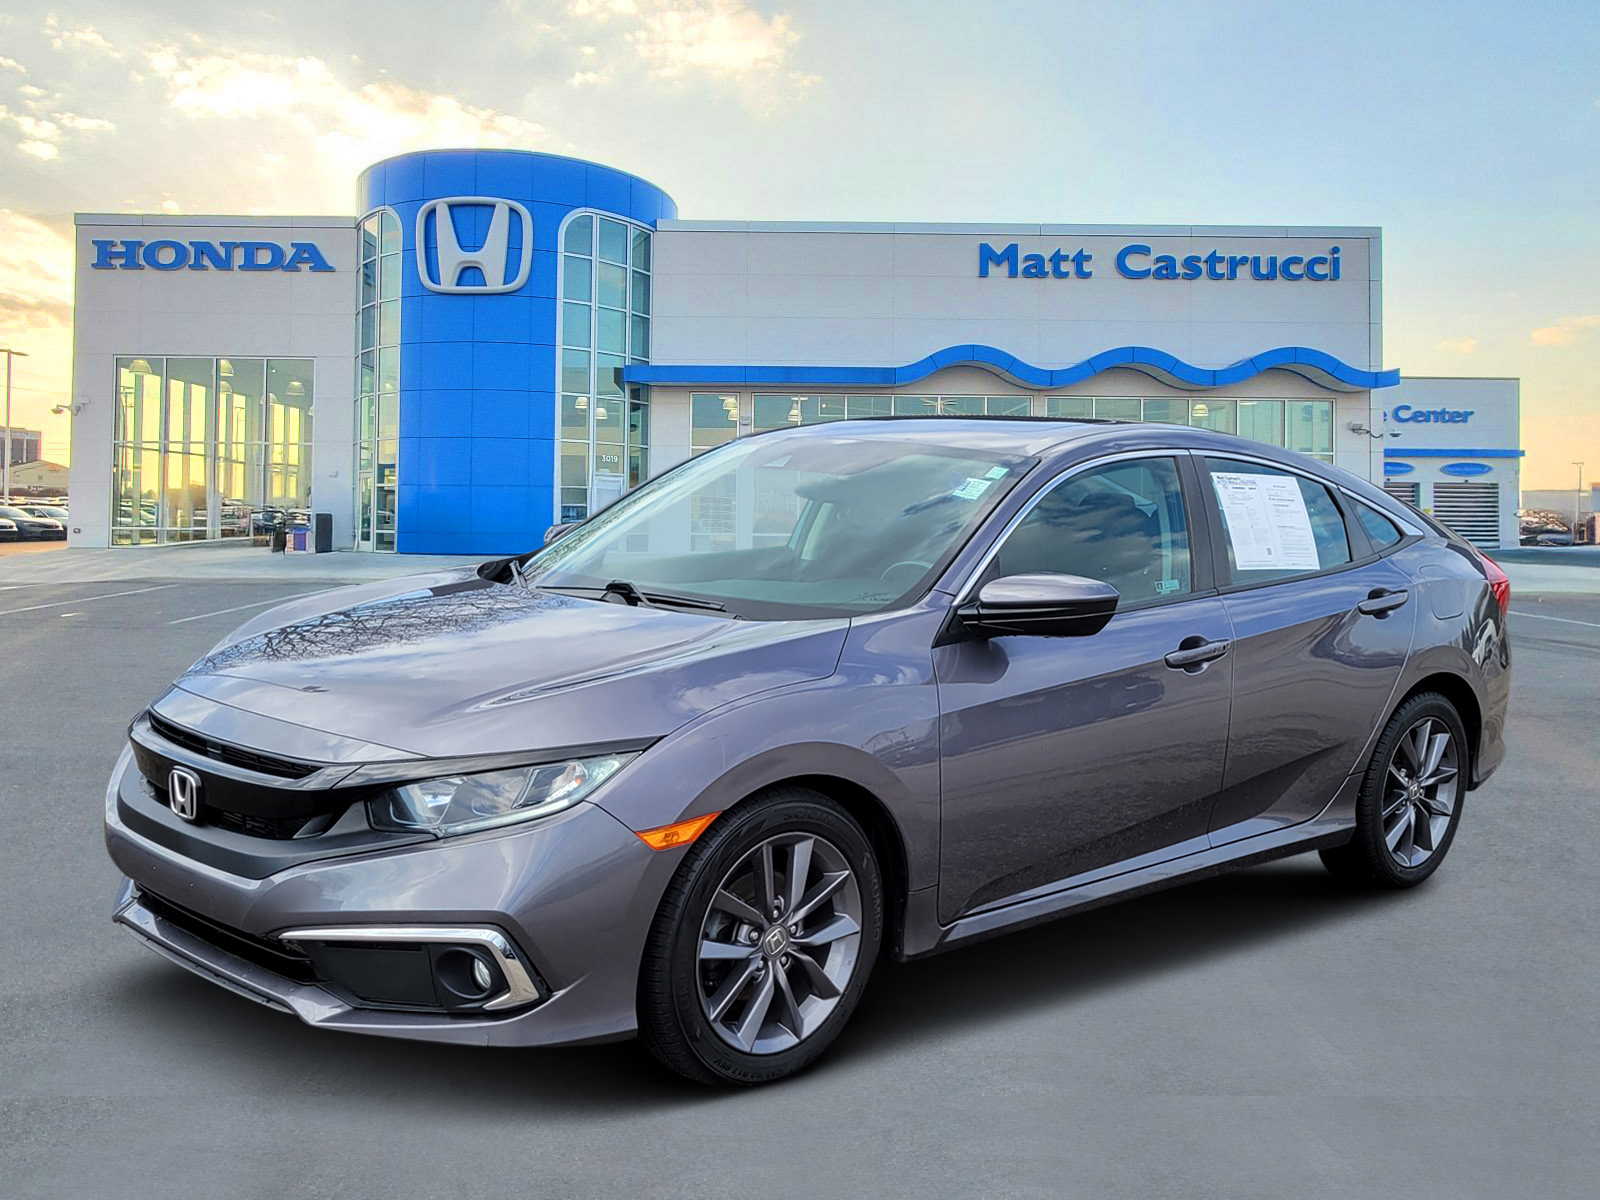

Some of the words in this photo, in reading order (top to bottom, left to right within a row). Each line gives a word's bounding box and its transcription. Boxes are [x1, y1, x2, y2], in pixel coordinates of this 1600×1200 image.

[91, 239, 337, 273] HONDA
[978, 241, 1093, 279] Matt
[1114, 243, 1342, 281] Castrucci
[1392, 404, 1475, 424] Center
[601, 454, 619, 463] 3019
[870, 873, 882, 942] KUMHO
